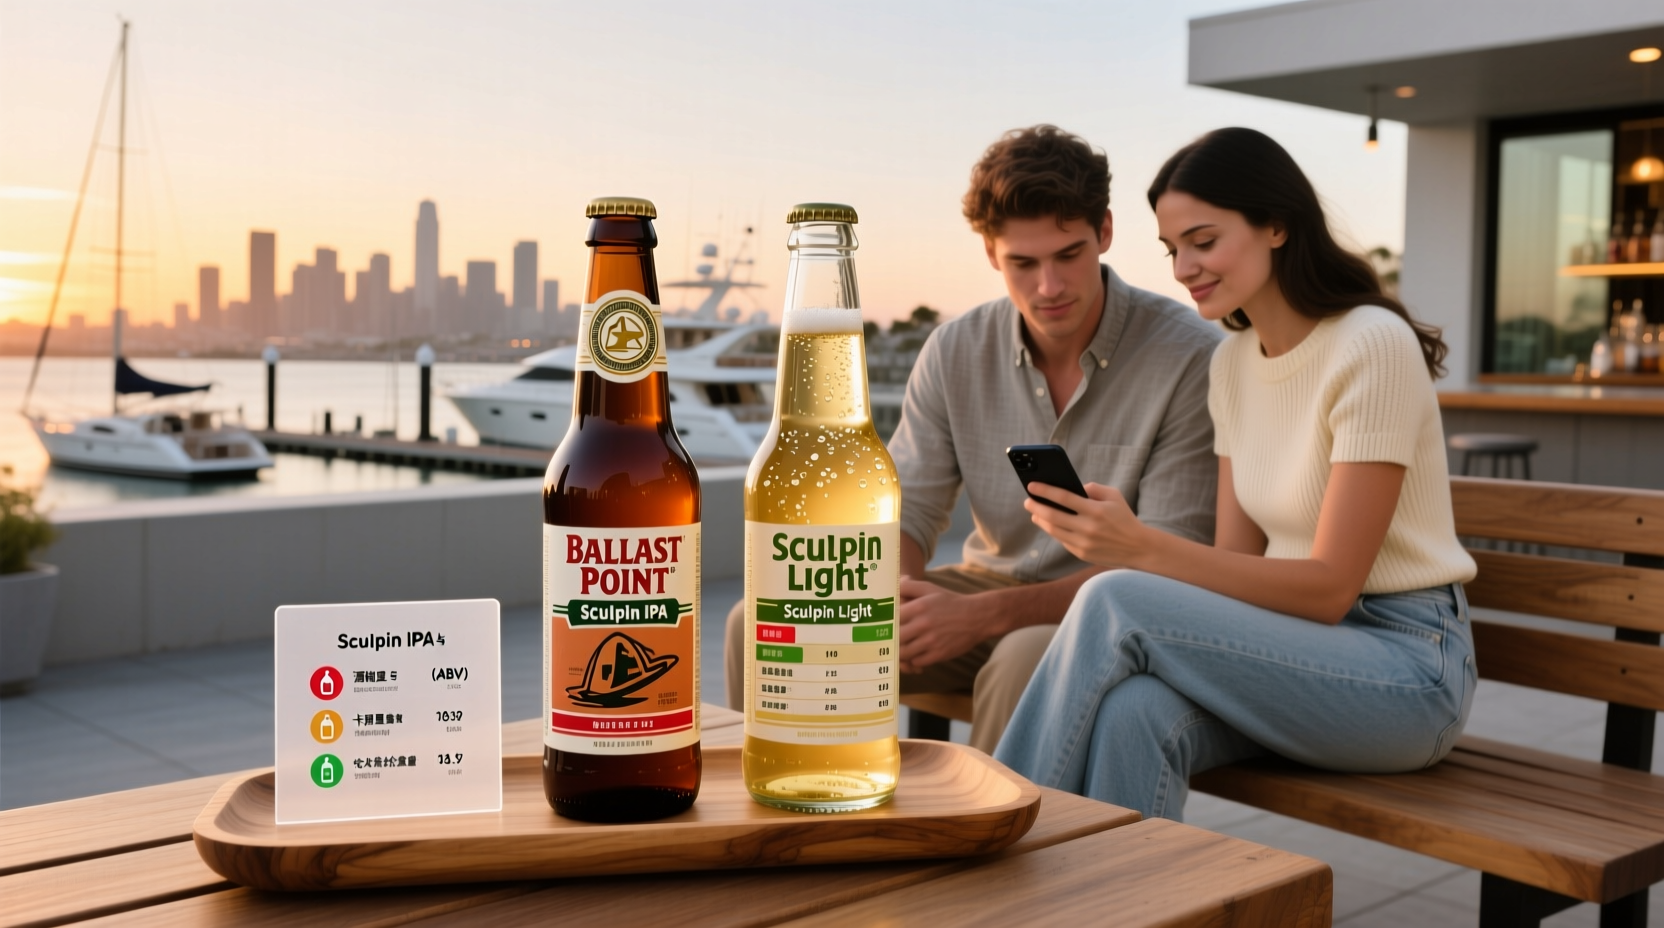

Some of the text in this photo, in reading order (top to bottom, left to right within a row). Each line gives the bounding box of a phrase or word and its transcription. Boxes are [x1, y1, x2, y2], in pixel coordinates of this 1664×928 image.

[566, 534, 682, 565] BALLAST
[772, 532, 881, 564] Sculpin
[580, 567, 669, 595] POINT
[644, 604, 668, 620] IPA
[783, 603, 872, 622] Sculpin Light
[337, 632, 402, 651] Sculpin
[431, 667, 469, 682] (ABV)
